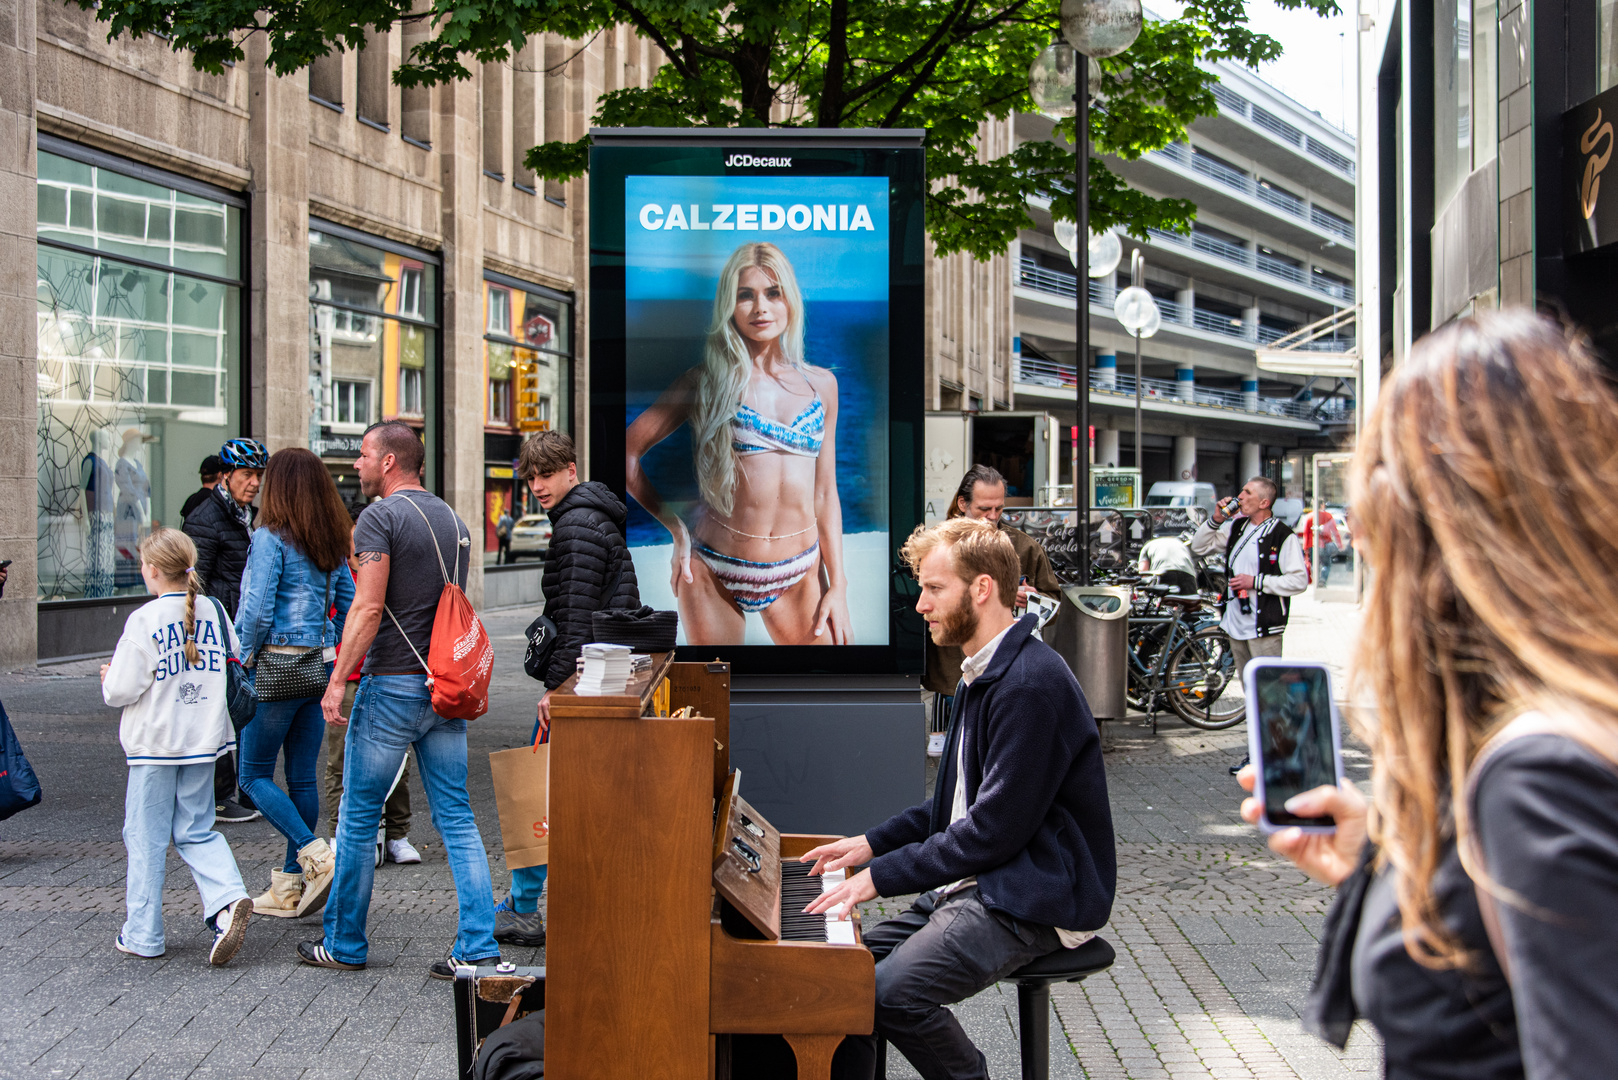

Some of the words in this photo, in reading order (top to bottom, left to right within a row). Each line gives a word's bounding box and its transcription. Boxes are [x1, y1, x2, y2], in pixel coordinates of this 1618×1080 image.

[725, 154, 792, 168] JCDecaux
[639, 203, 875, 231] CALZEDONIA
[1098, 493, 1129, 506] Vivaldi
[156, 649, 226, 681] SUNSE
